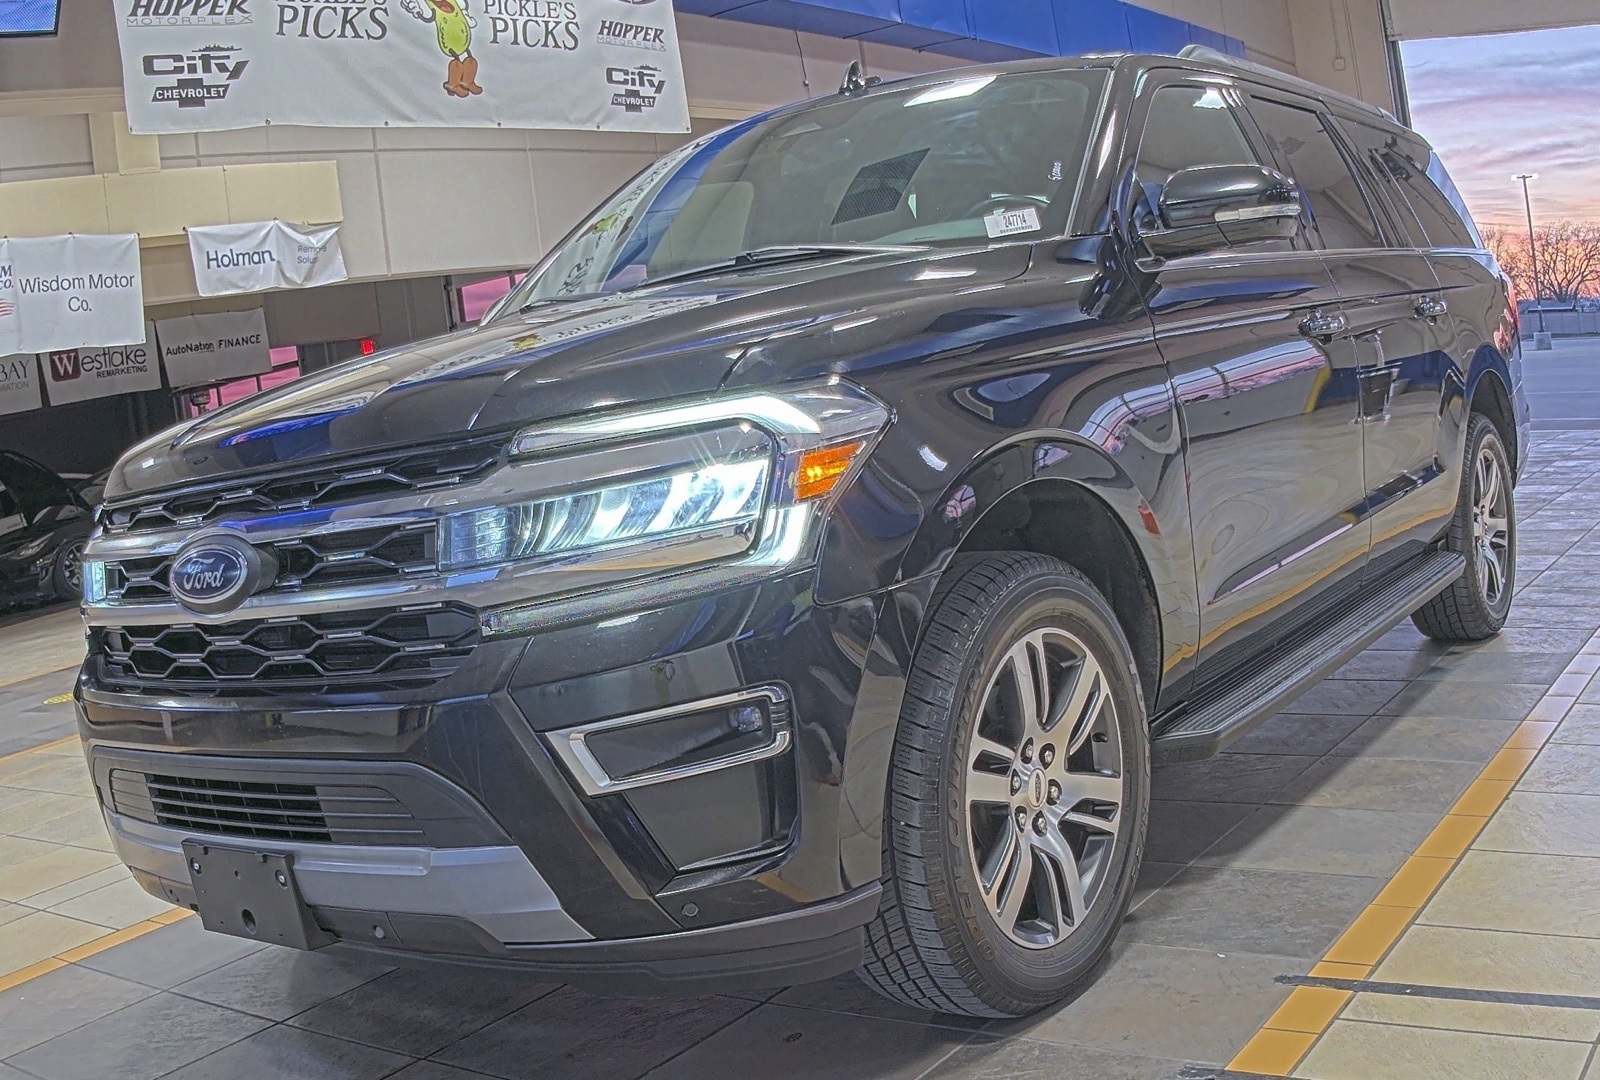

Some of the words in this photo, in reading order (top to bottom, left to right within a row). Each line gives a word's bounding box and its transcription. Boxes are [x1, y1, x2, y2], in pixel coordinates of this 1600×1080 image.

[127, 0, 251, 17] HOPPER
[483, 0, 577, 20] PICKLE'S
[126, 15, 254, 26] MOTORPLEX
[275, 4, 390, 41] PICKS
[489, 16, 580, 51] PICKS
[598, 20, 665, 43] HOPPER
[597, 35, 667, 51] MOTORPLEX
[142, 53, 250, 81] City
[605, 66, 666, 95] City
[155, 87, 226, 100] CHEVROLET
[612, 95, 655, 107] CHEVROLET
[1003, 213, 1027, 228] 247714
[206, 248, 276, 269] Holman
[19, 275, 86, 294] Wisdom
[88, 273, 136, 290] Motor
[68, 296, 93, 313] Co.
[165, 341, 216, 356] AutoNation
[218, 333, 262, 350] FINANCE
[96, 364, 148, 379] REMARKETING
[183, 557, 226, 591] Ford
